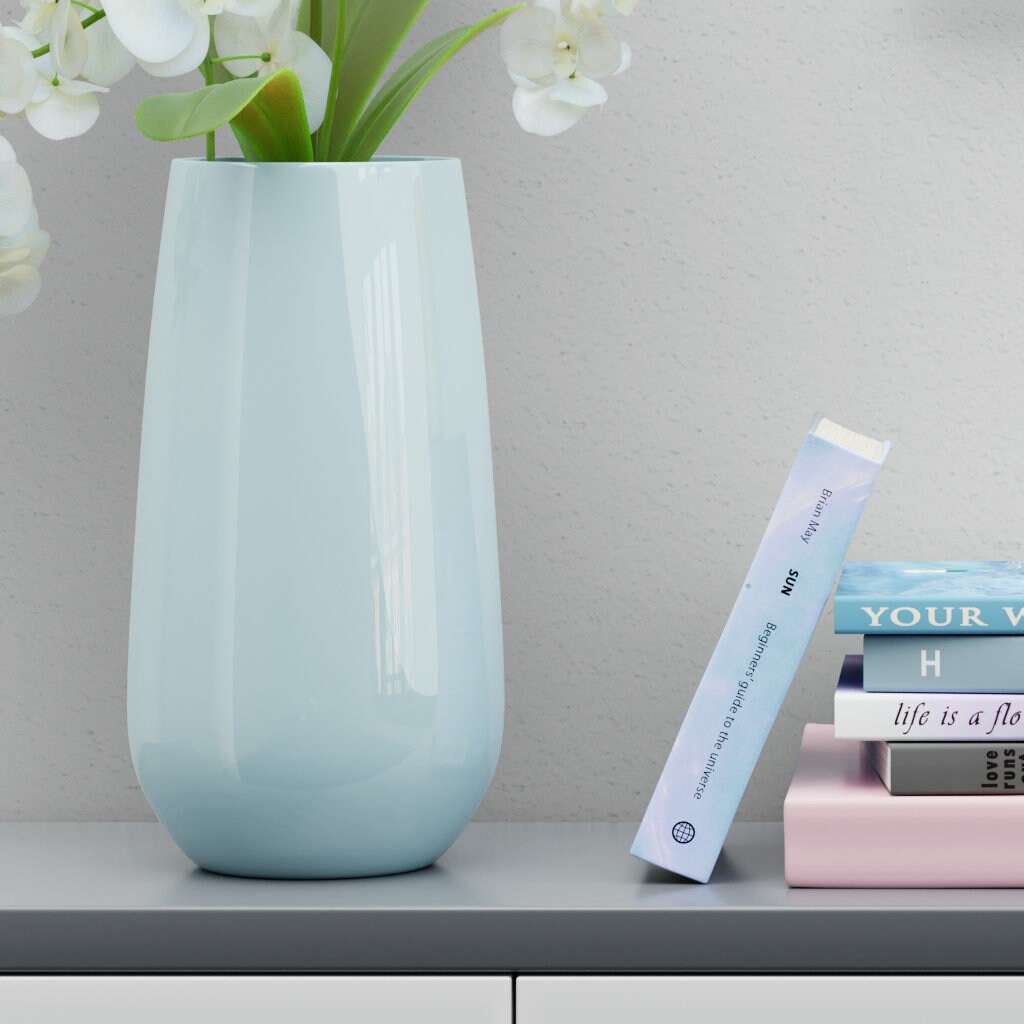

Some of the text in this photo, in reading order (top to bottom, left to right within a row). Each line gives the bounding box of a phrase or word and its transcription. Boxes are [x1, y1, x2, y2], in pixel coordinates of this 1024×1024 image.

[800, 488, 833, 545] Brian May
[780, 568, 799, 597] SUN
[861, 606, 988, 627] YOUR
[729, 680, 749, 714] guide
[723, 716, 735, 729] to
[894, 701, 930, 735] life
[940, 703, 958, 726] is
[968, 710, 984, 726] a
[713, 731, 729, 750] the
[693, 752, 719, 800] universe
[981, 750, 998, 788] love
[1003, 748, 1016, 789] runs
